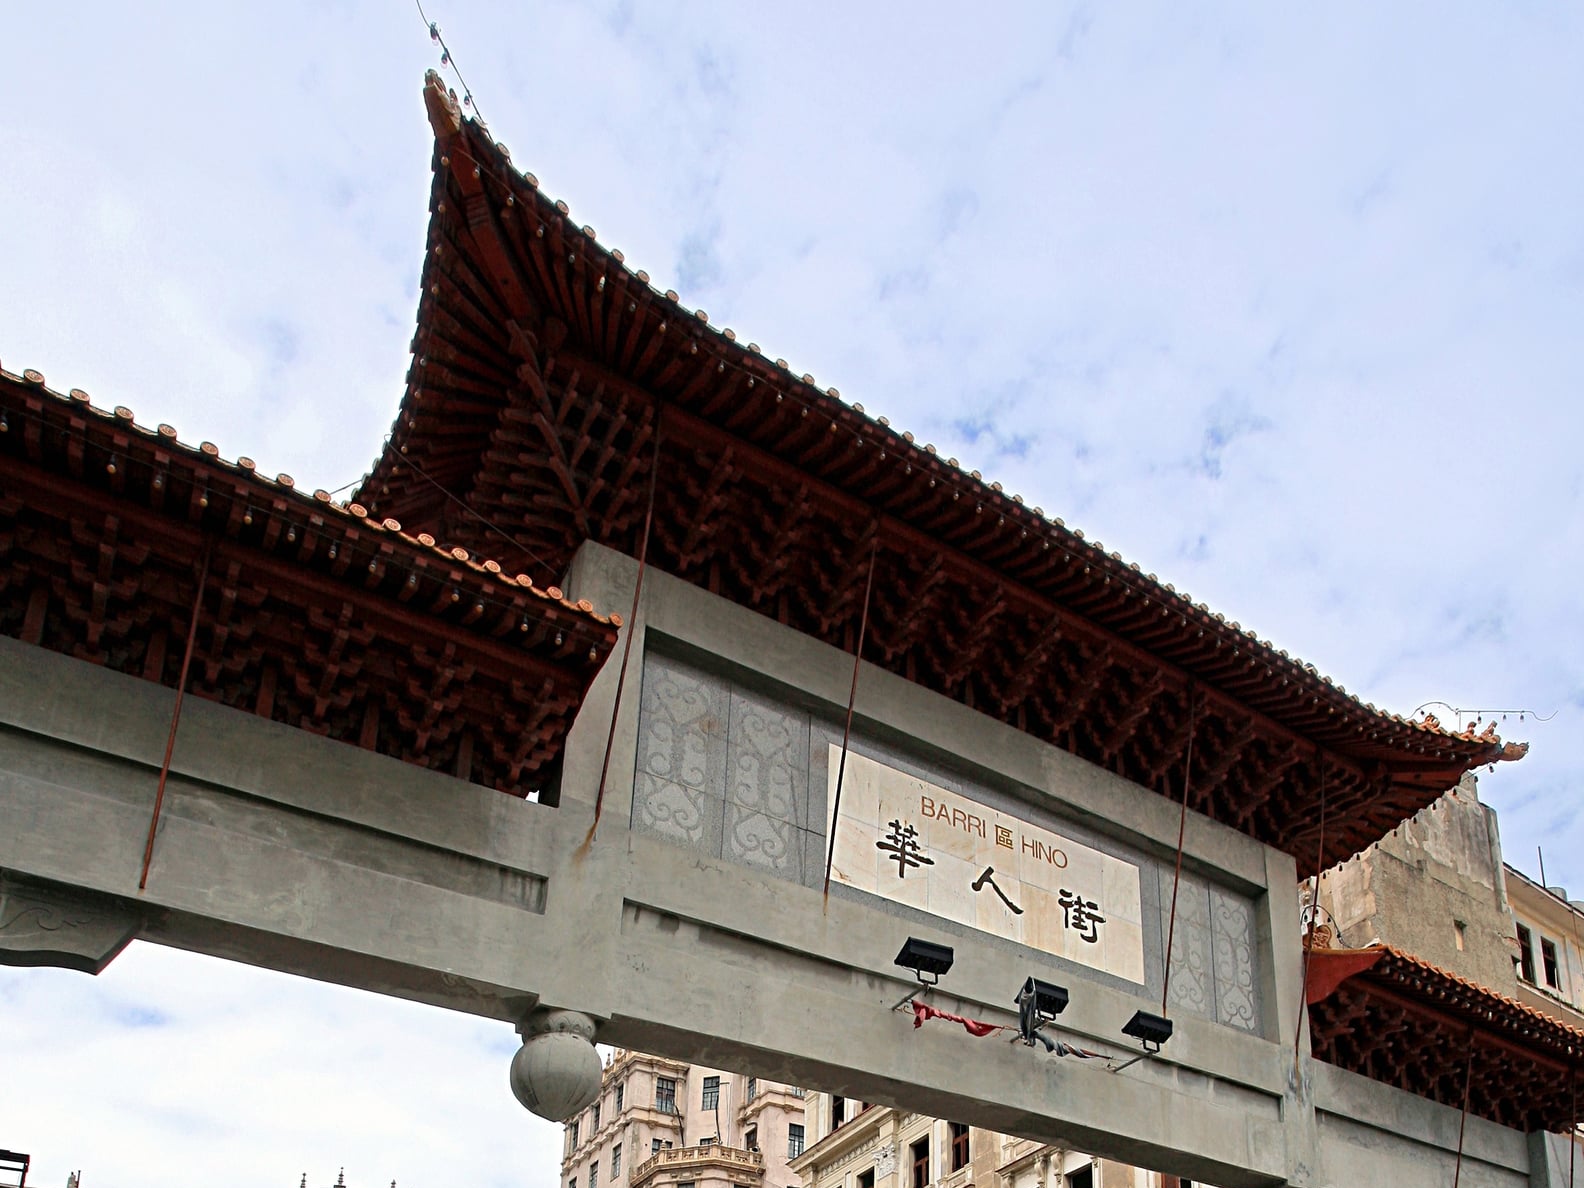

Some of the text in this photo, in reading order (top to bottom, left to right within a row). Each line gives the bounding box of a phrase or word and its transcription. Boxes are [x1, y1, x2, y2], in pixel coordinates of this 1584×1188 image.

[876, 819, 1106, 943] 華人街
[921, 796, 986, 838] BARRI
[1022, 836, 1069, 869] HINO
